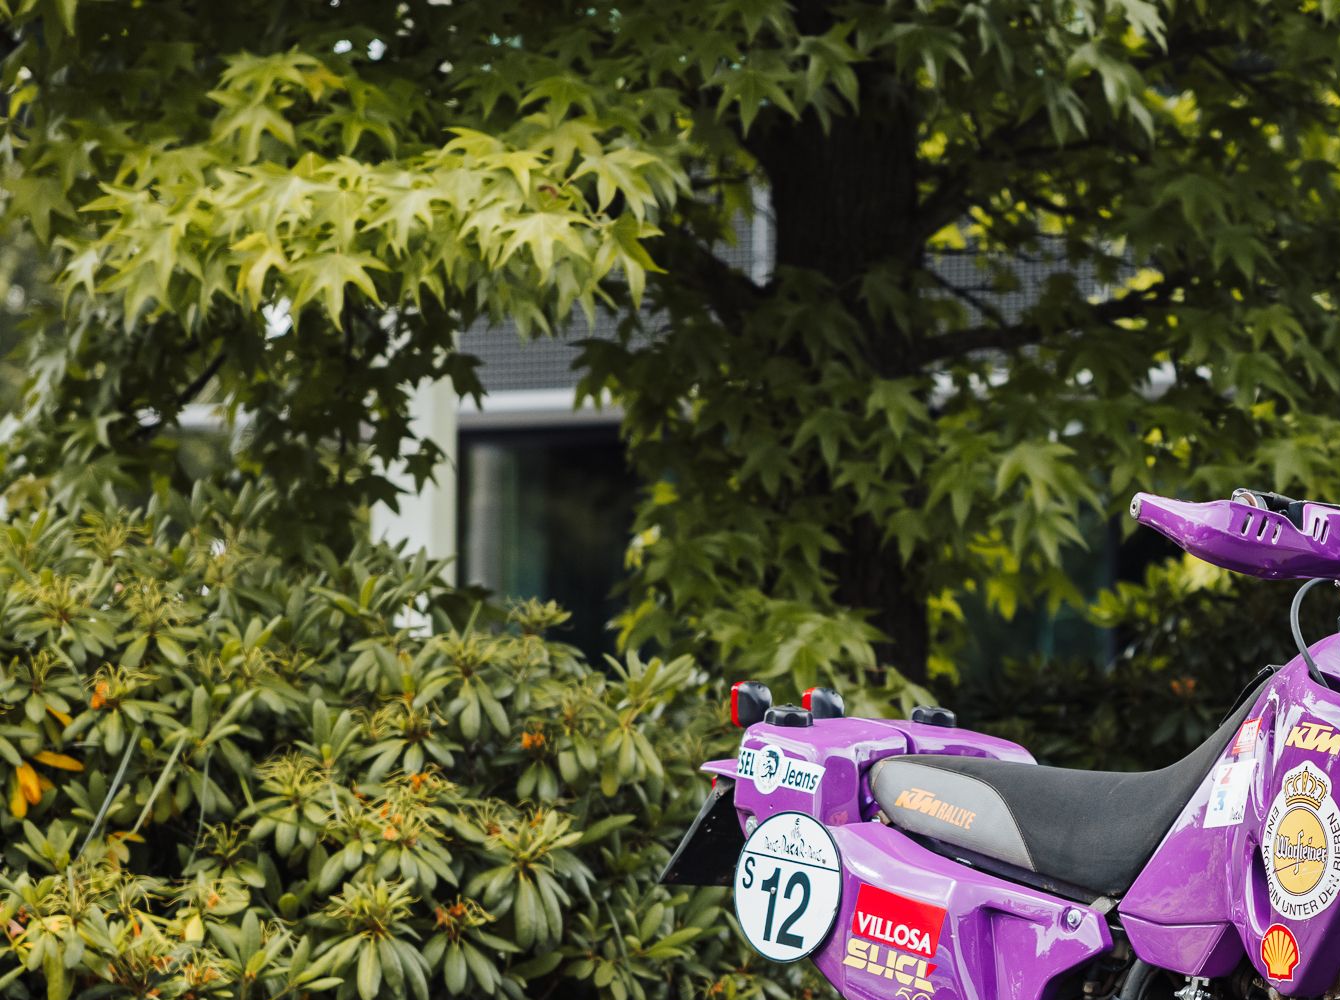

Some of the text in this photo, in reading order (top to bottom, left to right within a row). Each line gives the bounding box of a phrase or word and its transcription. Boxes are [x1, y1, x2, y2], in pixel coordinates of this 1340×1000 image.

[782, 761, 819, 791] Jeans
[894, 787, 977, 831] KTM RALLYE
[1265, 806, 1280, 841] EINE
[1281, 899, 1319, 916] UNTER
[742, 856, 811, 950] S 12
[857, 910, 932, 955] VILLOSA
[842, 937, 939, 994] SLICK
